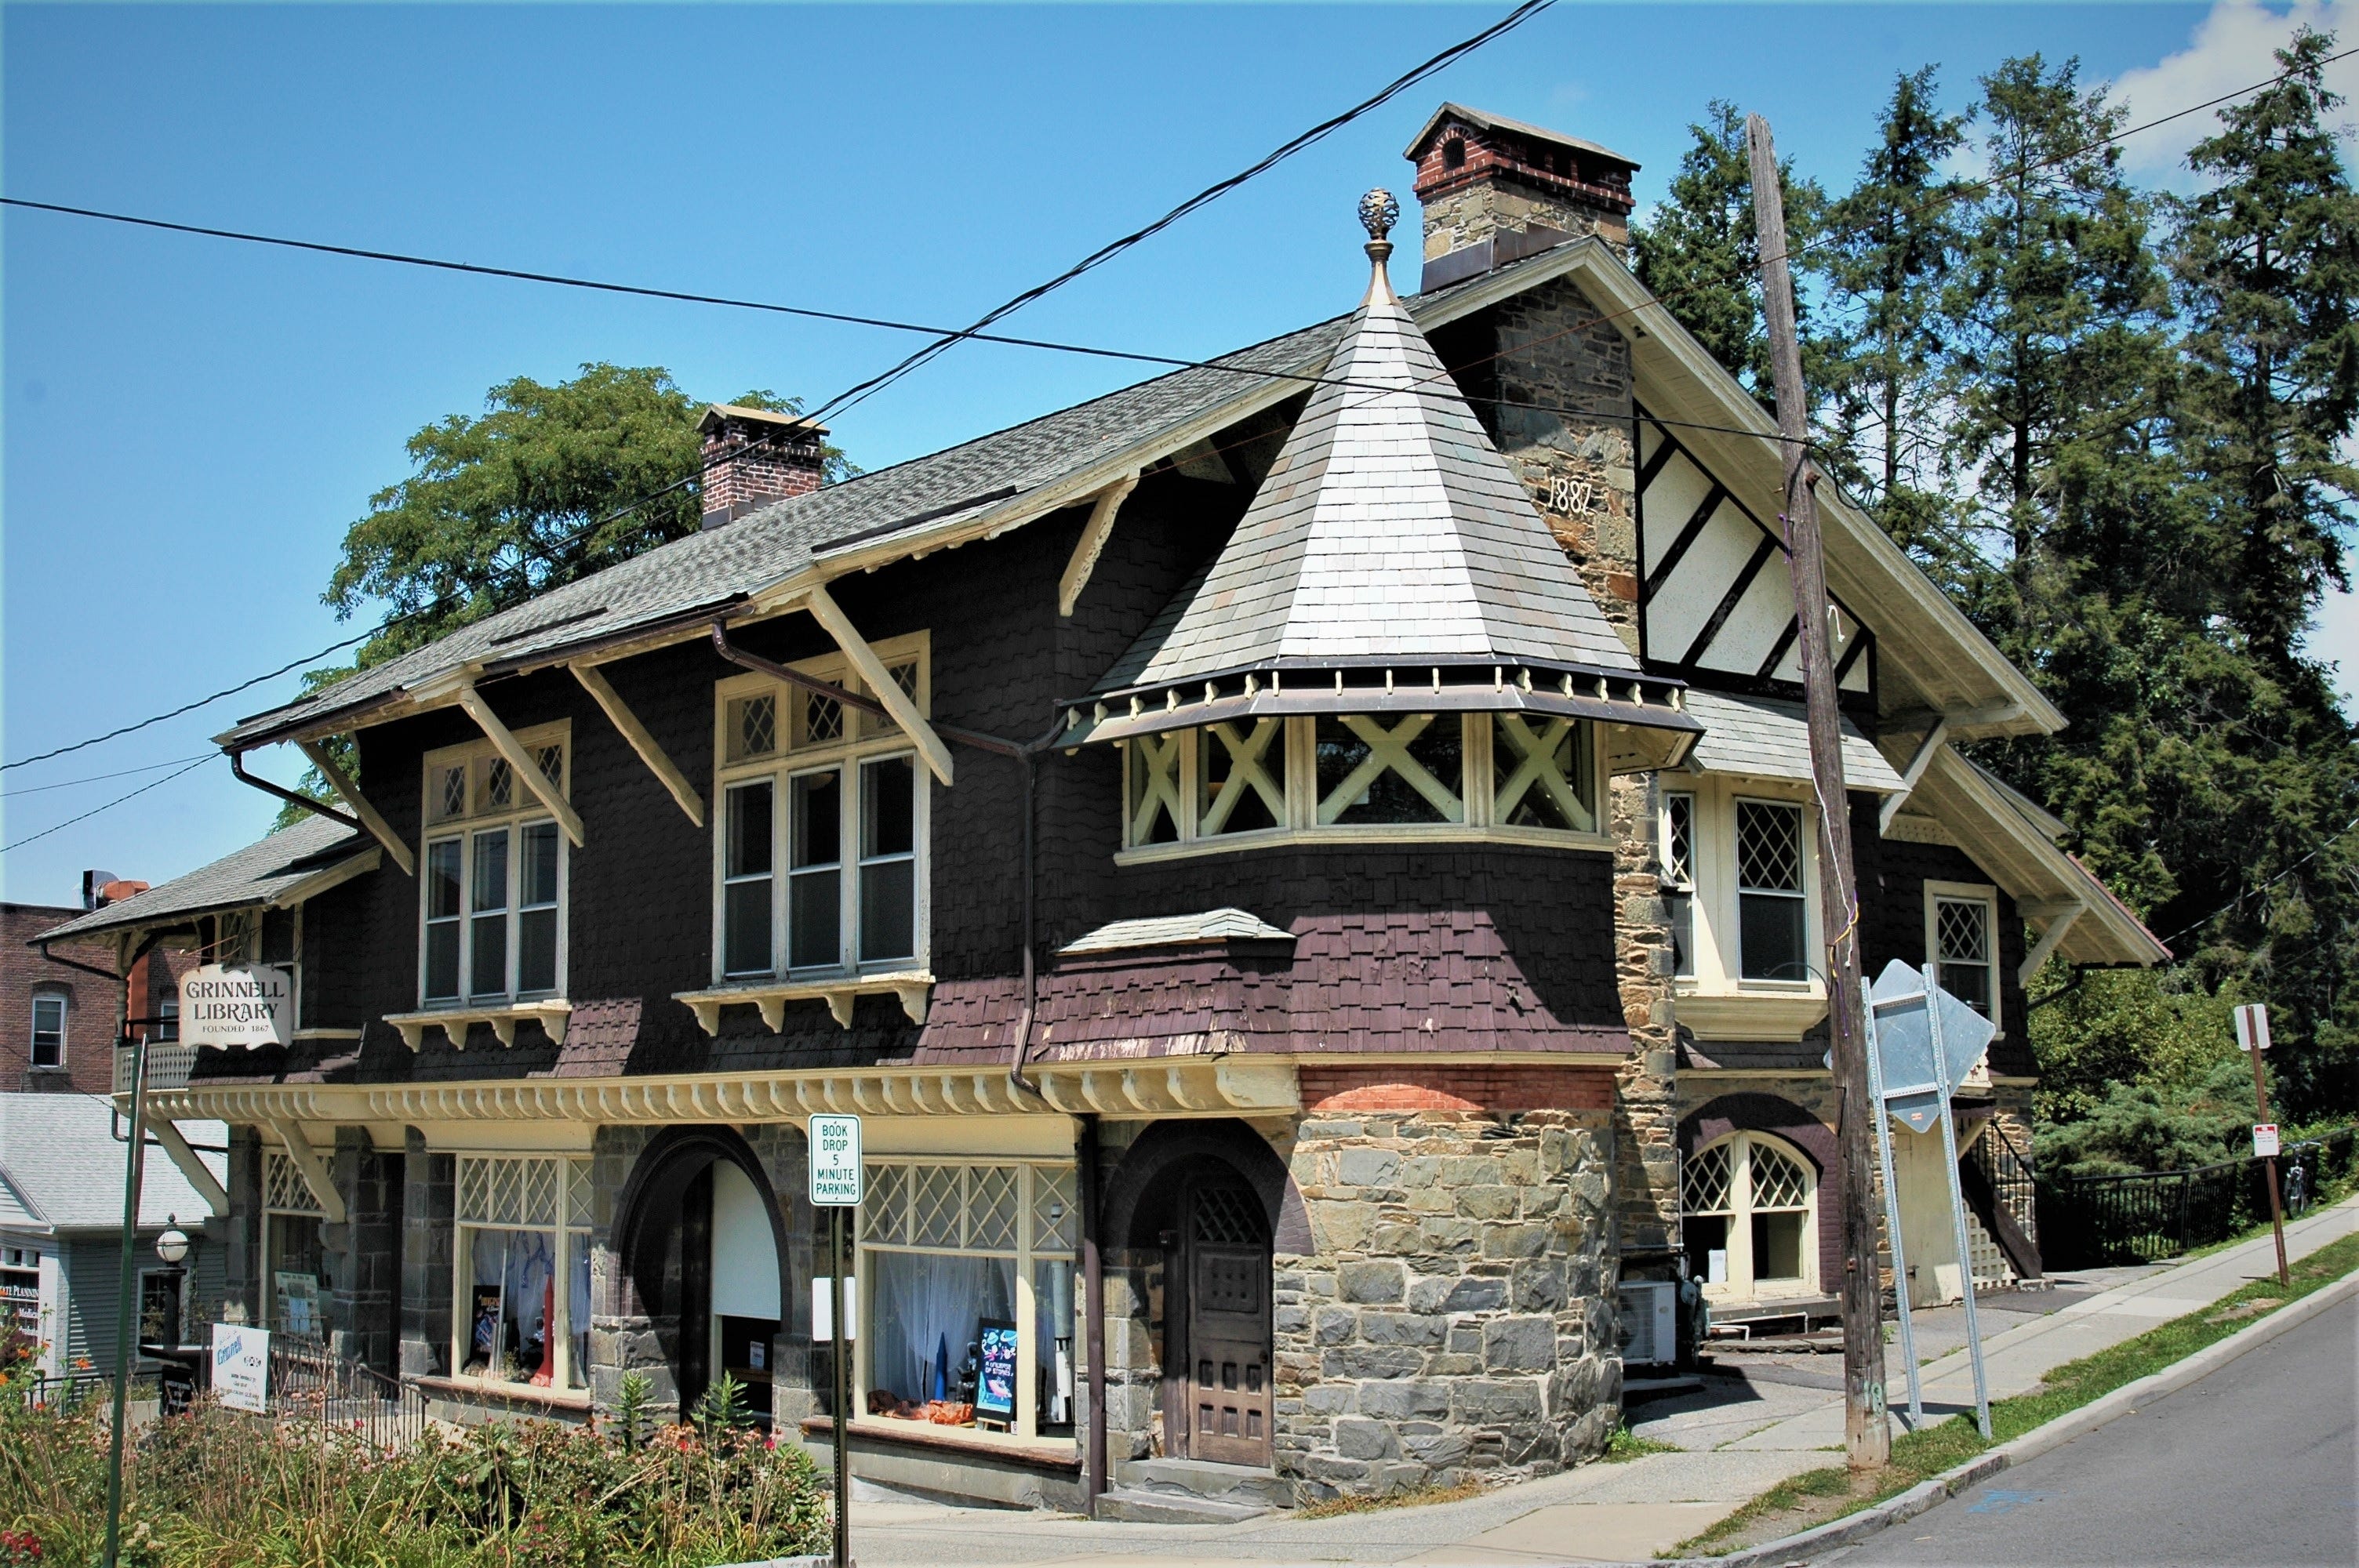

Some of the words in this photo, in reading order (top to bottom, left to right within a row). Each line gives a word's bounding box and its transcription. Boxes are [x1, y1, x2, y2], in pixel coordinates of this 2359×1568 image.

[1547, 476, 1592, 516] 1887
[186, 981, 285, 998] GRINNELL
[194, 1003, 278, 1023] LIBRARY
[202, 1025, 245, 1033] FOUNDED
[822, 1124, 848, 1137] BOOK
[823, 1139, 849, 1152] DROP
[833, 1154, 839, 1166] 5
[817, 1168, 855, 1181] MINUTE
[816, 1183, 856, 1196] PARKING
